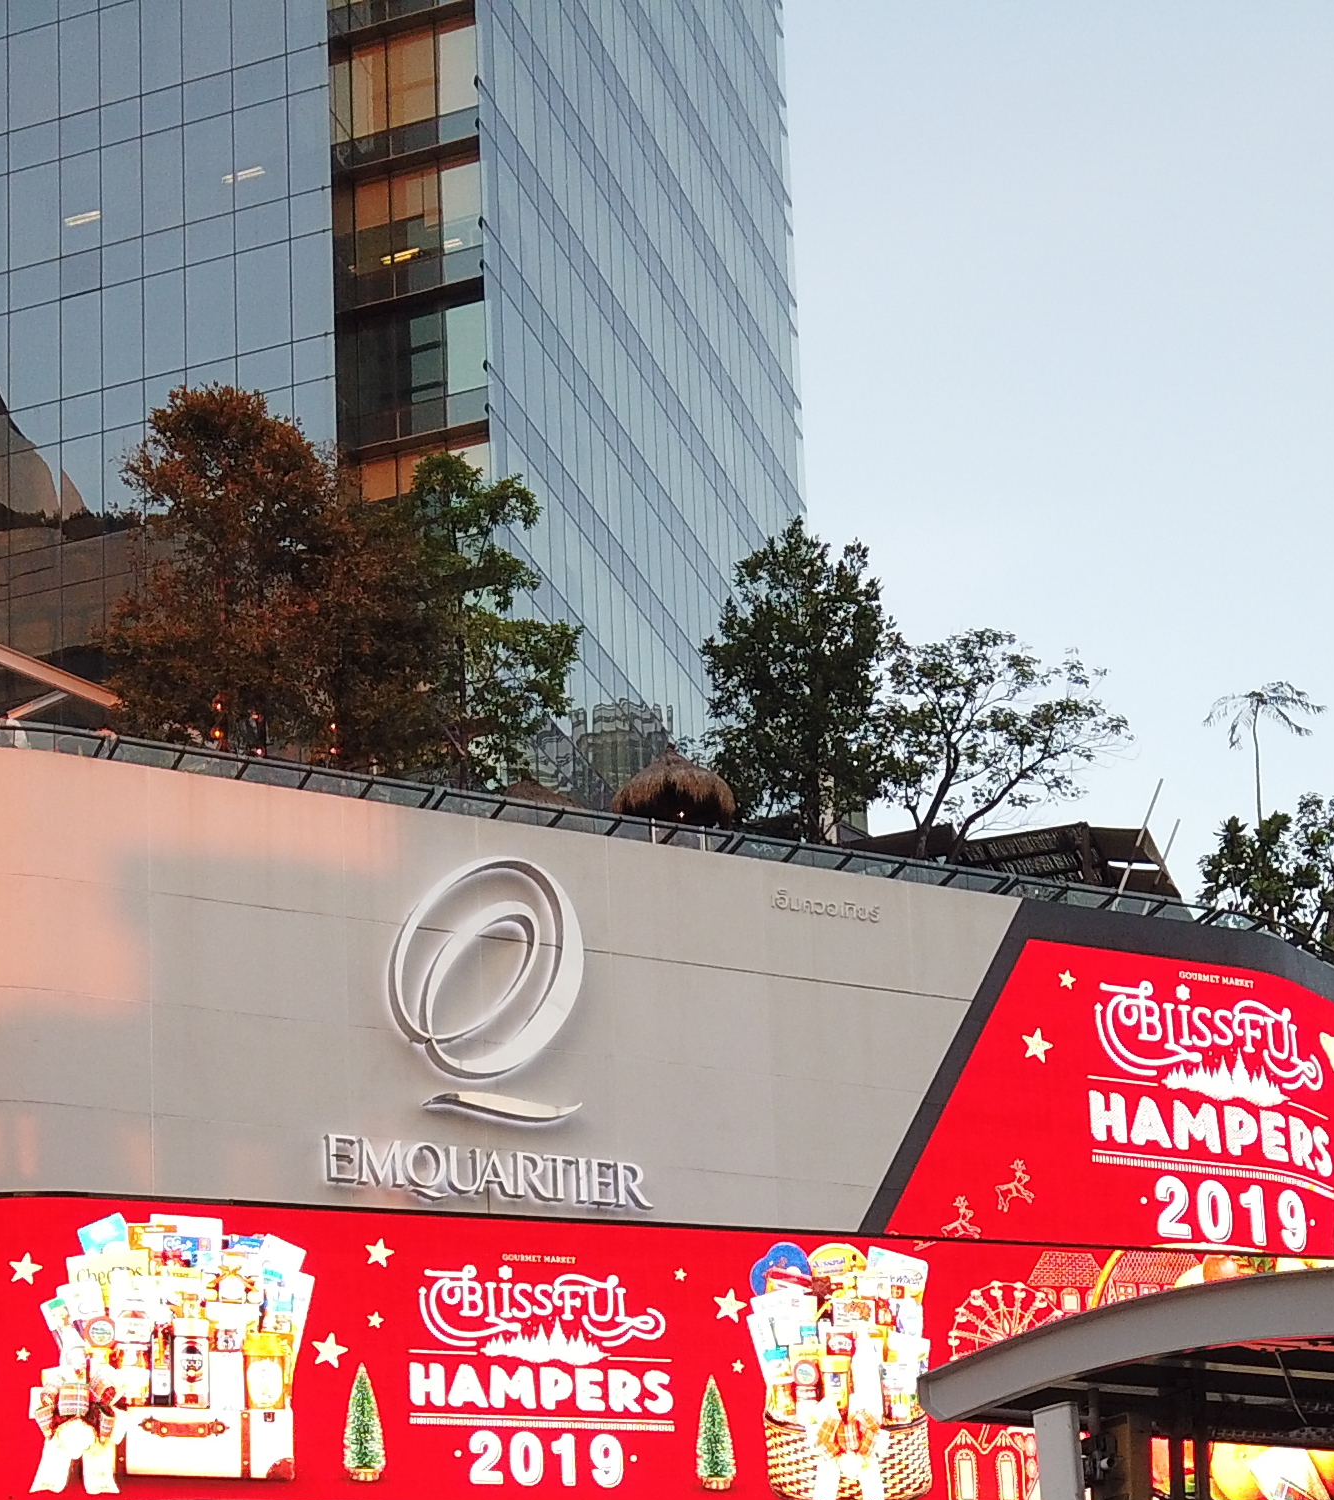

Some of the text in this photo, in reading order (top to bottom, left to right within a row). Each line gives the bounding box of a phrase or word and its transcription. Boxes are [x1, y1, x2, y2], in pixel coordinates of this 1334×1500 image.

[1178, 970, 1255, 989] GOURMET MARKET
[1088, 1090, 1334, 1178] HAMPERS
[323, 1133, 654, 1210] EMQUARTIER
[1154, 1175, 1307, 1252] 2019
[502, 1253, 577, 1265] GOURMET MARKET
[409, 1362, 674, 1415] HAMPERS
[469, 1431, 624, 1488] 2019
